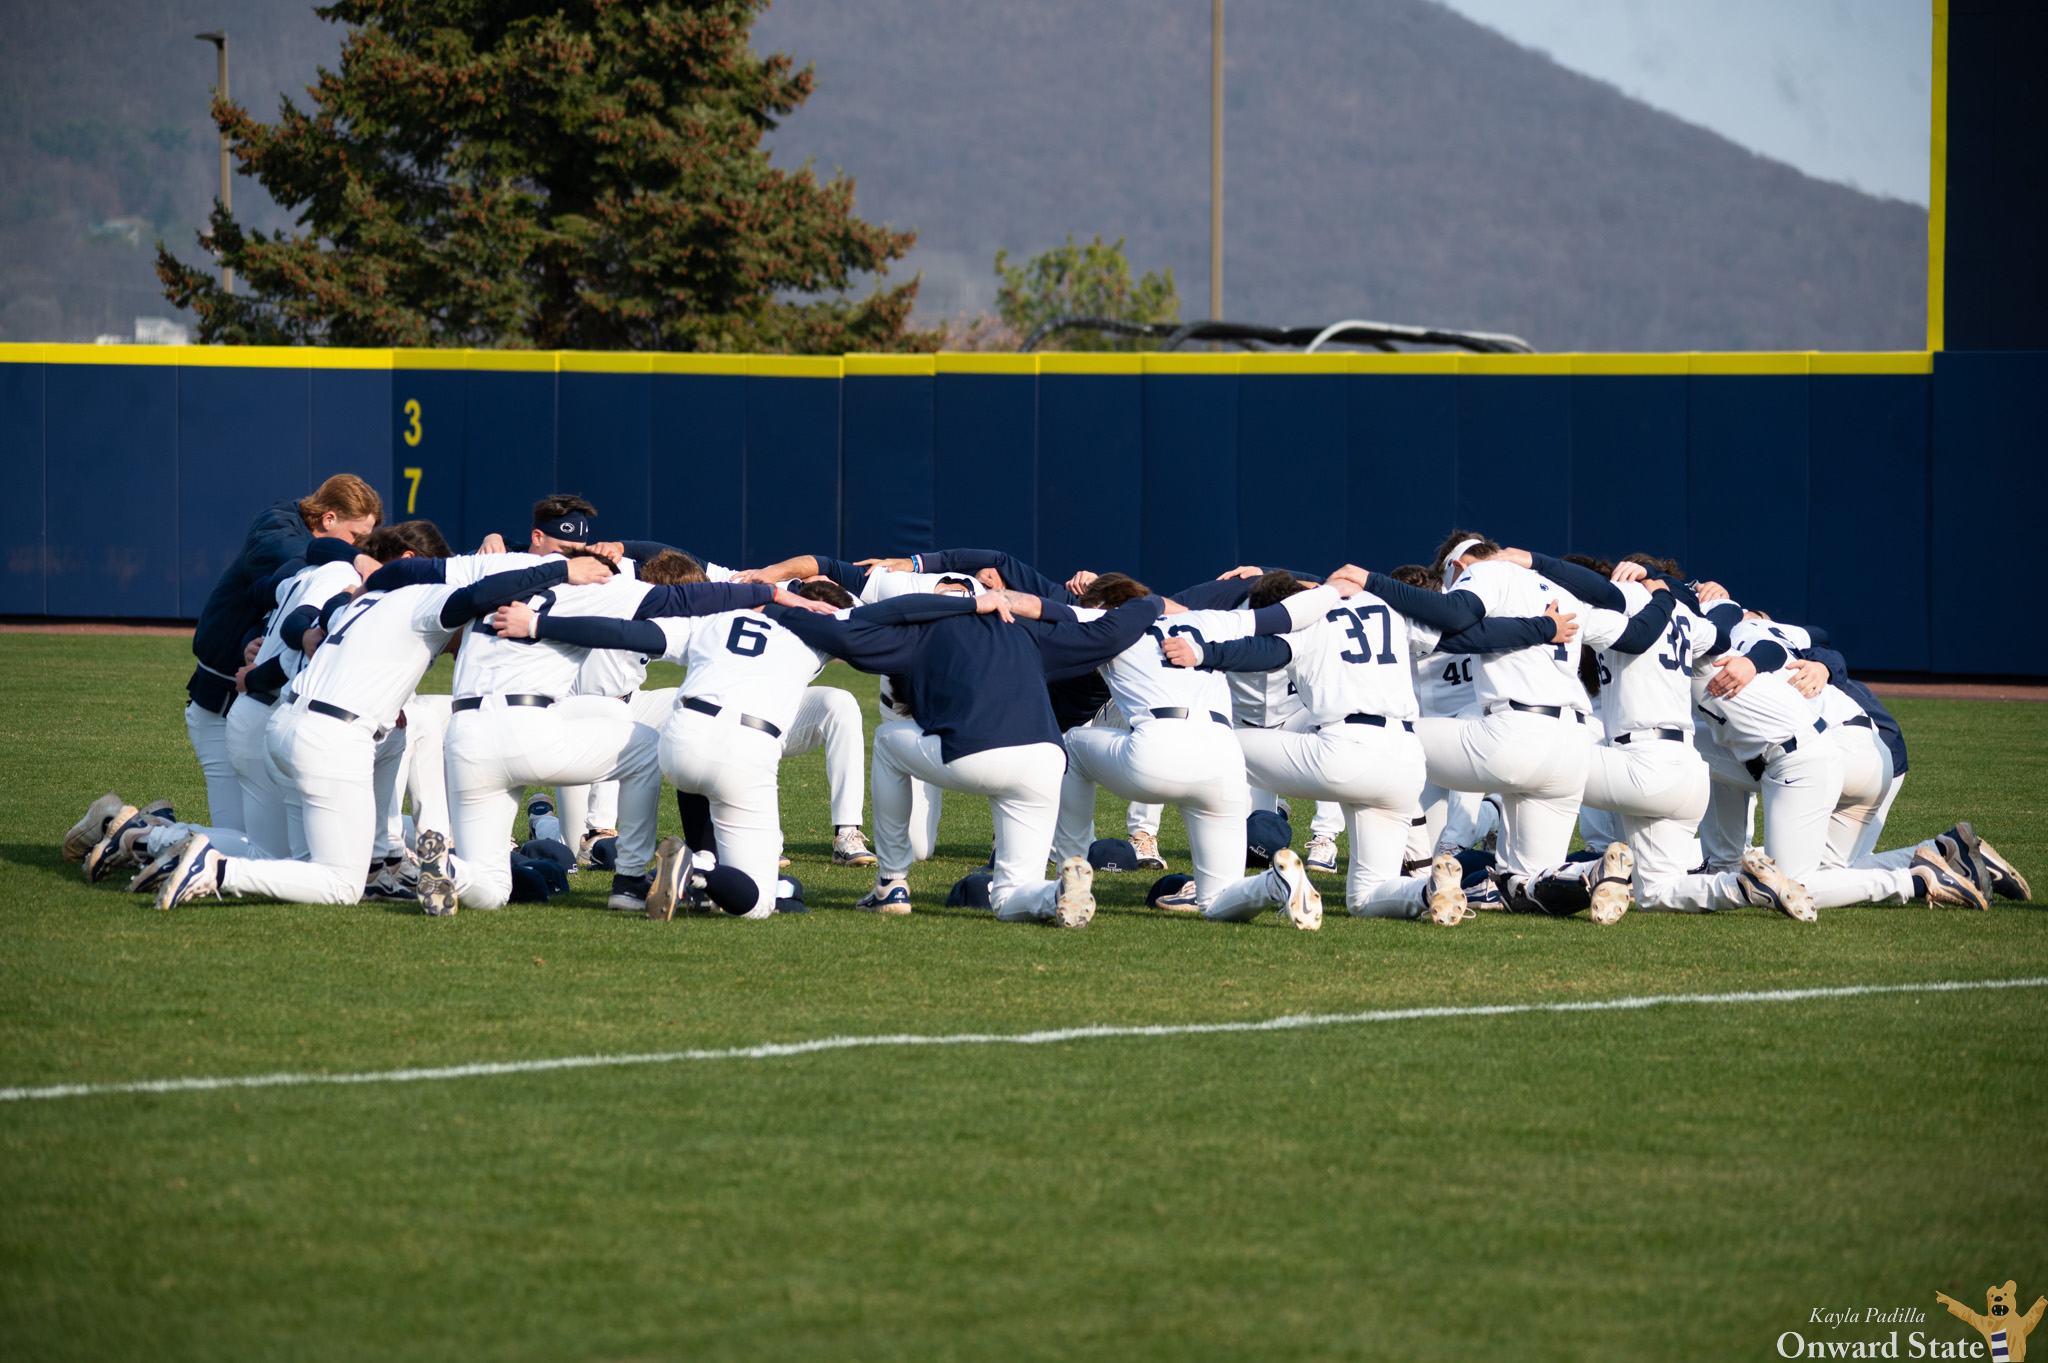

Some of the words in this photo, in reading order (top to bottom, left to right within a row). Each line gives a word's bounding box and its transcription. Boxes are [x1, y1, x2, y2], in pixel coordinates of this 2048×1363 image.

[326, 598, 381, 645] 7
[726, 616, 772, 657] 6
[1326, 605, 1398, 665] 37
